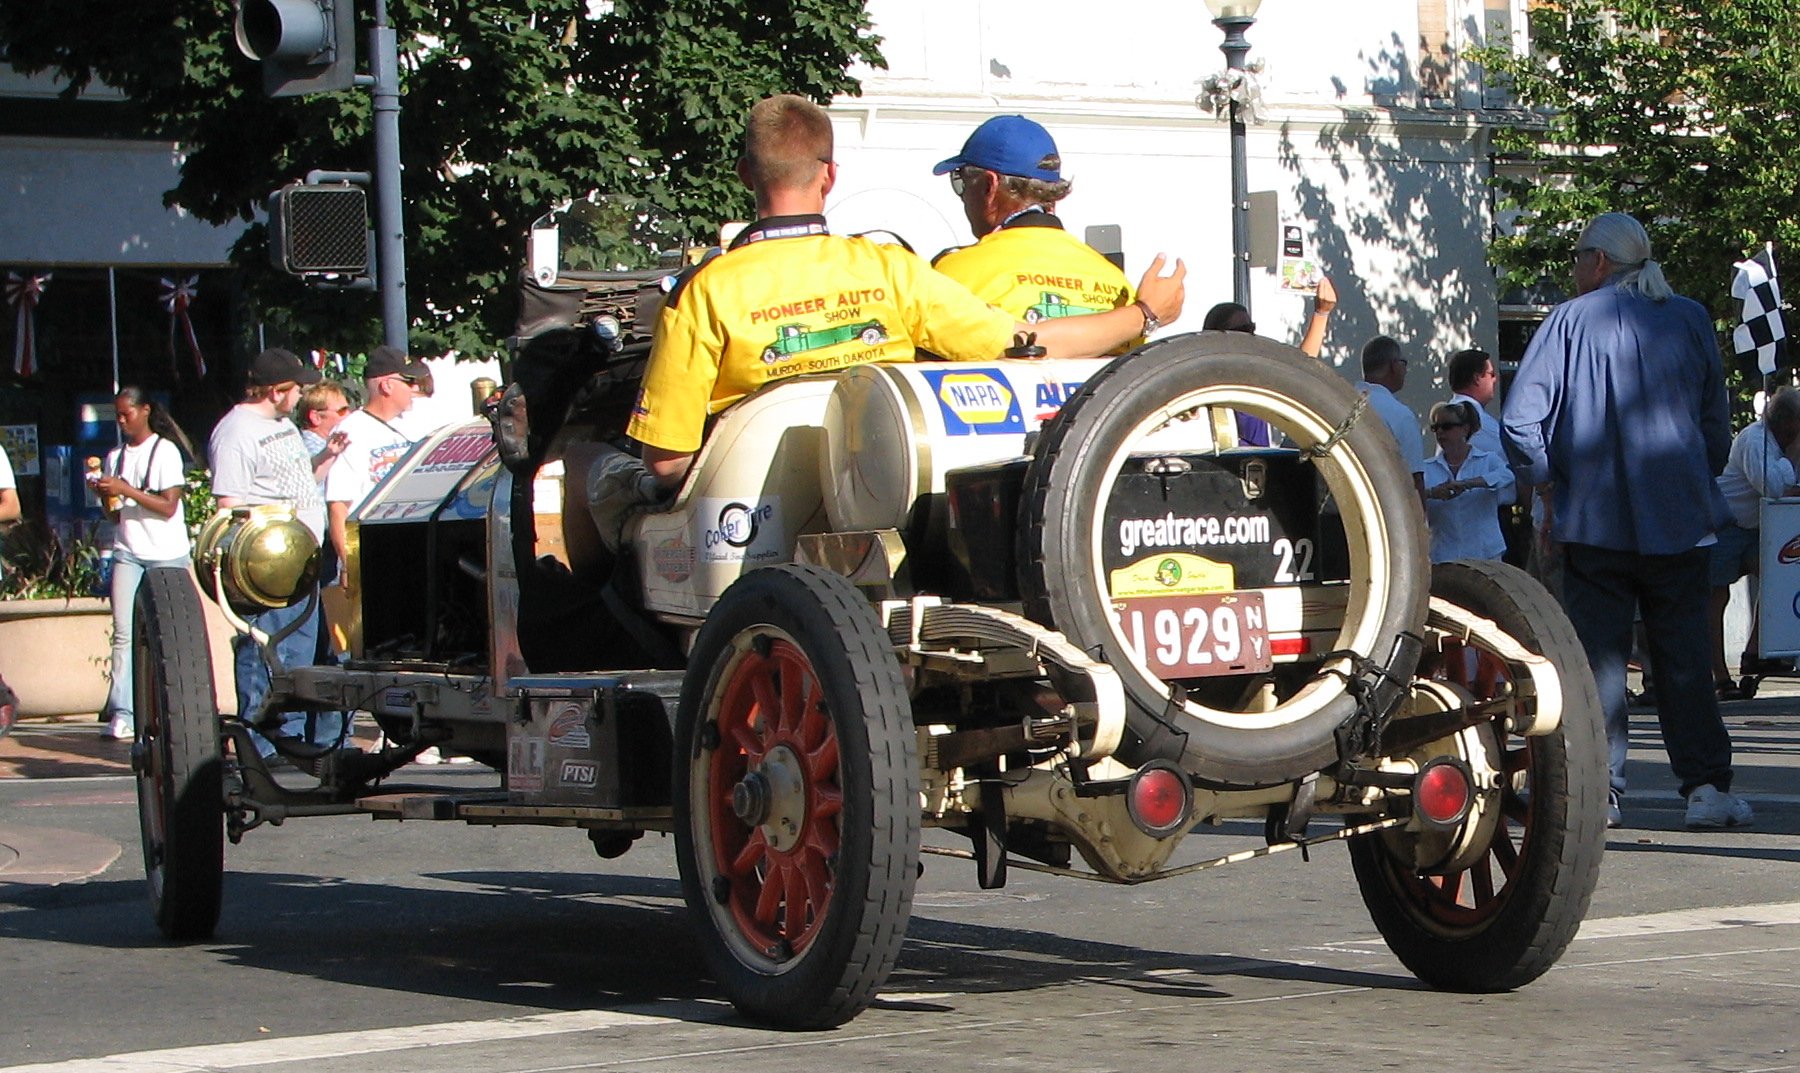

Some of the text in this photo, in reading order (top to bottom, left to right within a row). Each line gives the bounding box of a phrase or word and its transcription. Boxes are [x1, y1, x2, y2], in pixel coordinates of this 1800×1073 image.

[1017, 274, 1119, 295] PIONEER AUT
[751, 288, 885, 325] PIONEER AUTO
[824, 307, 861, 324] SHOW
[808, 356, 840, 371] SOUTH
[844, 348, 886, 365] DAKOTA
[950, 384, 1002, 407] NAPA
[705, 519, 741, 549] Coker
[1119, 511, 1271, 557] greatrace.com
[1272, 537, 1315, 583] 22
[1113, 606, 1242, 668] 1929
[563, 764, 595, 783] PTSI
